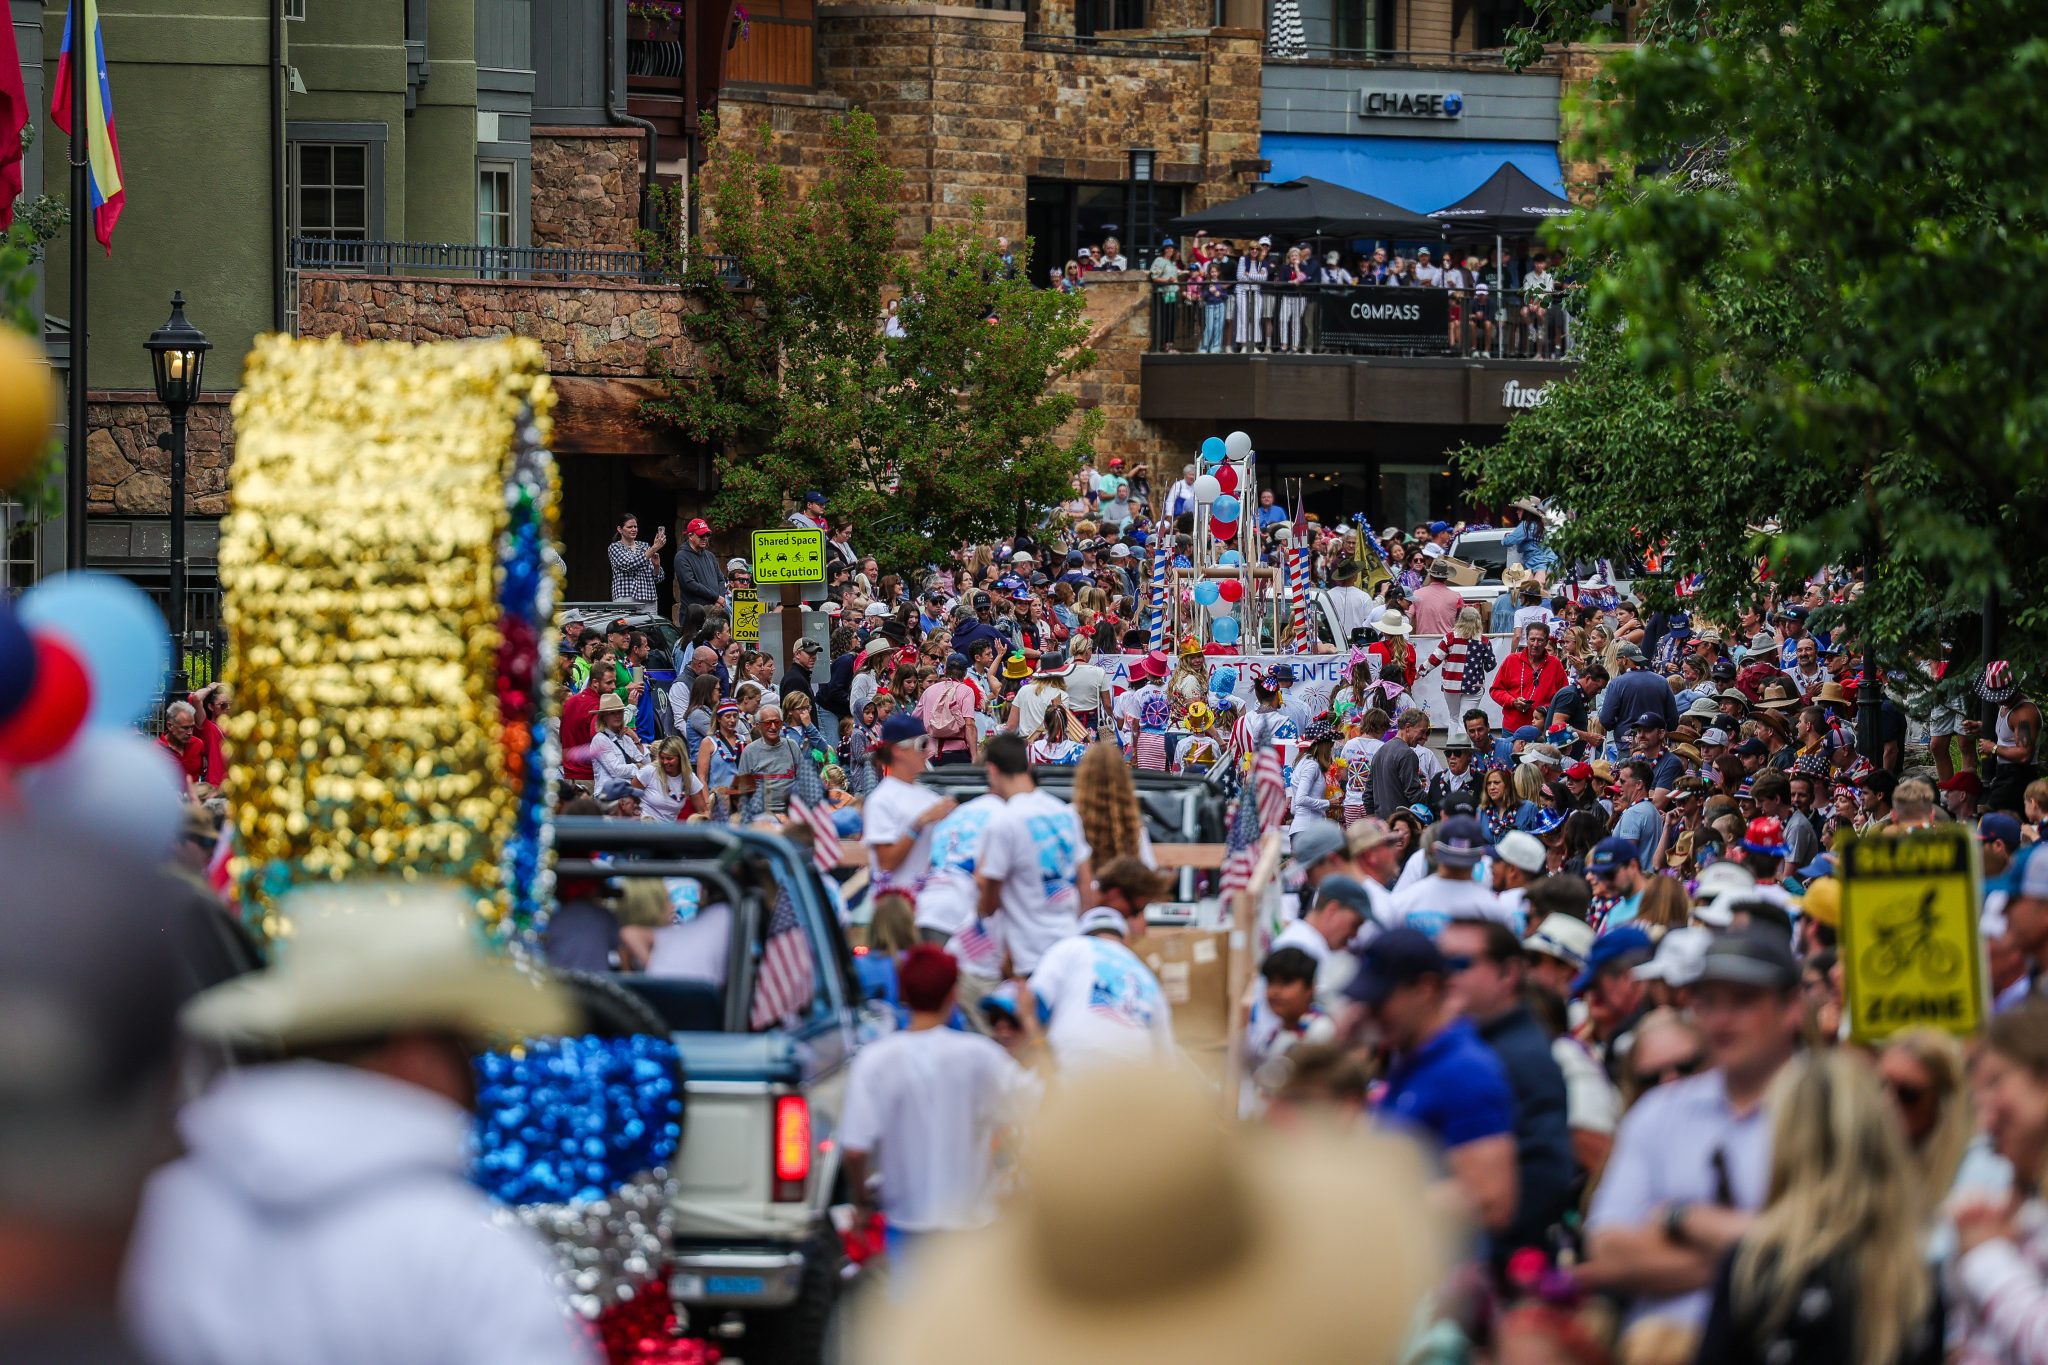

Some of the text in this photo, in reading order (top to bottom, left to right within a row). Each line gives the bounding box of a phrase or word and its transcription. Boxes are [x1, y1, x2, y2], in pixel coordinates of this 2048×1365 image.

[1367, 92, 1443, 114] CHASE
[1350, 302, 1420, 320] COMPASS
[758, 536, 818, 546] Shared Space
[759, 566, 819, 578] Use Caution
[1208, 662, 1350, 682] ATS ENTER
